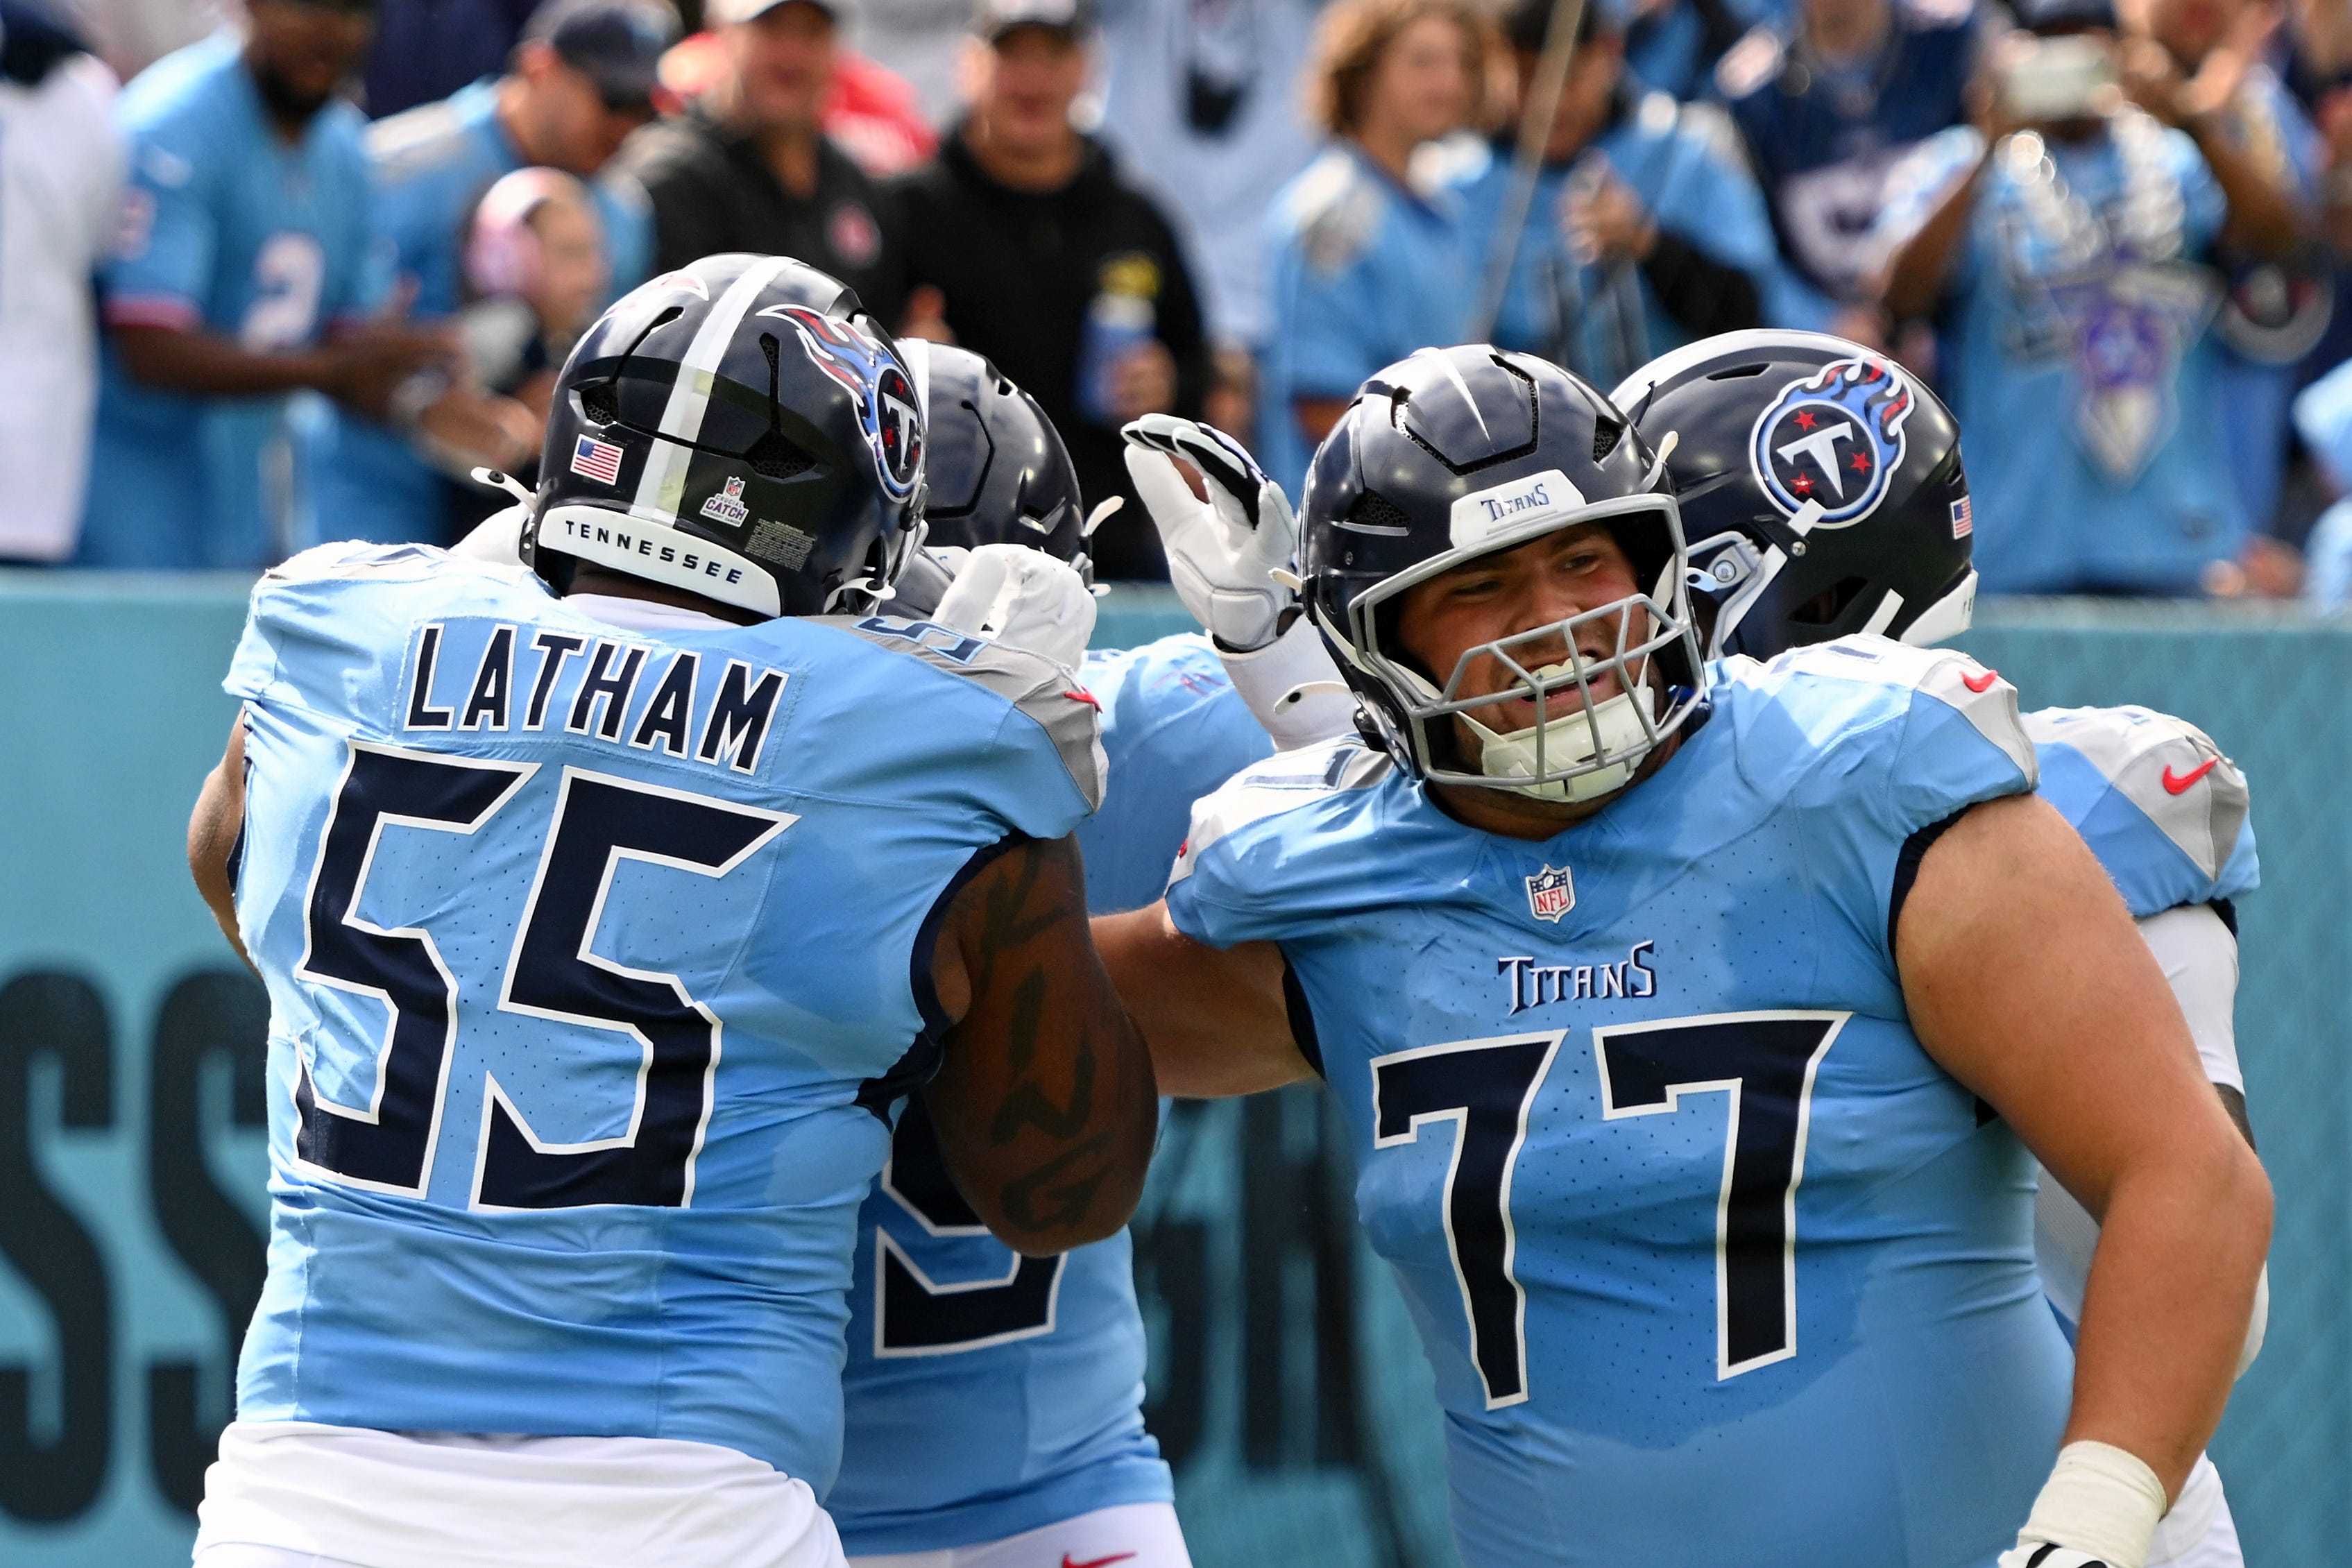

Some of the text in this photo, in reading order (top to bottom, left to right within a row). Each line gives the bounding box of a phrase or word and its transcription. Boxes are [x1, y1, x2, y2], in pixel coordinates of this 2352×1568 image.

[1776, 421, 1855, 500] T
[706, 500, 747, 520] CATCH
[715, 495, 744, 508] CRUCIAL
[565, 520, 742, 584] TENNESSEE
[403, 623, 790, 776] LATHAM
[1535, 888, 1568, 912] NFL
[296, 738, 803, 1211] 55
[1497, 939, 1658, 1016] TITANS
[1370, 1010, 1854, 1411] 77
